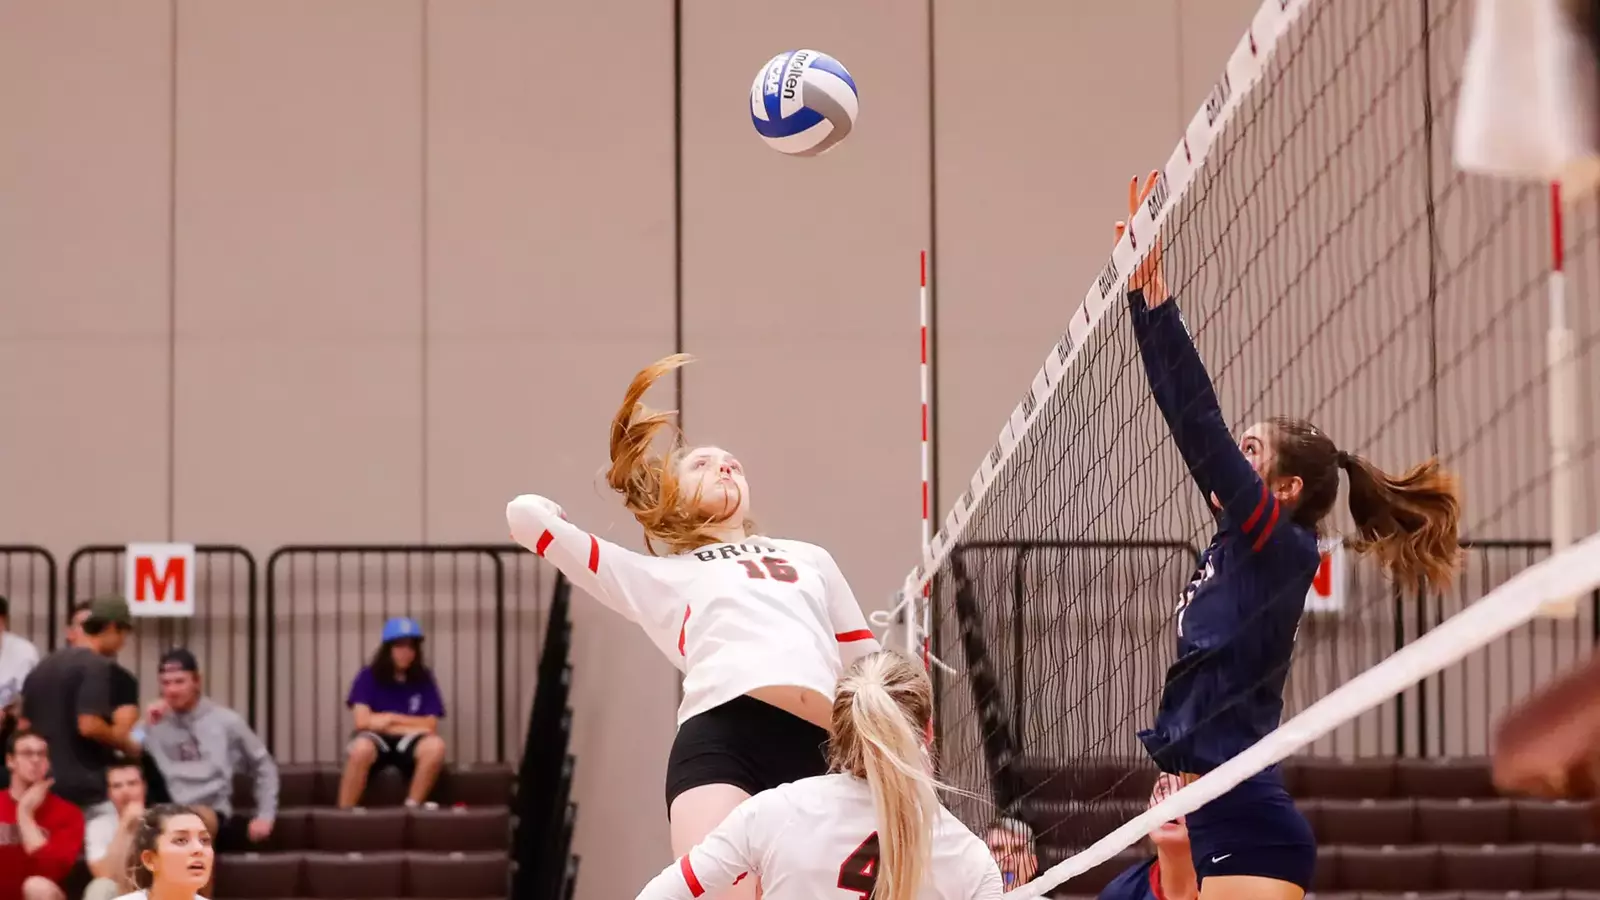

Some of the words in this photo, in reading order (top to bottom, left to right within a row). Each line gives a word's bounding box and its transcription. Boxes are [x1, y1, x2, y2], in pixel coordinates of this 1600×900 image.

[784, 52, 809, 99] molten
[135, 556, 185, 602] M
[737, 556, 799, 583] 16
[837, 830, 880, 900] 4
